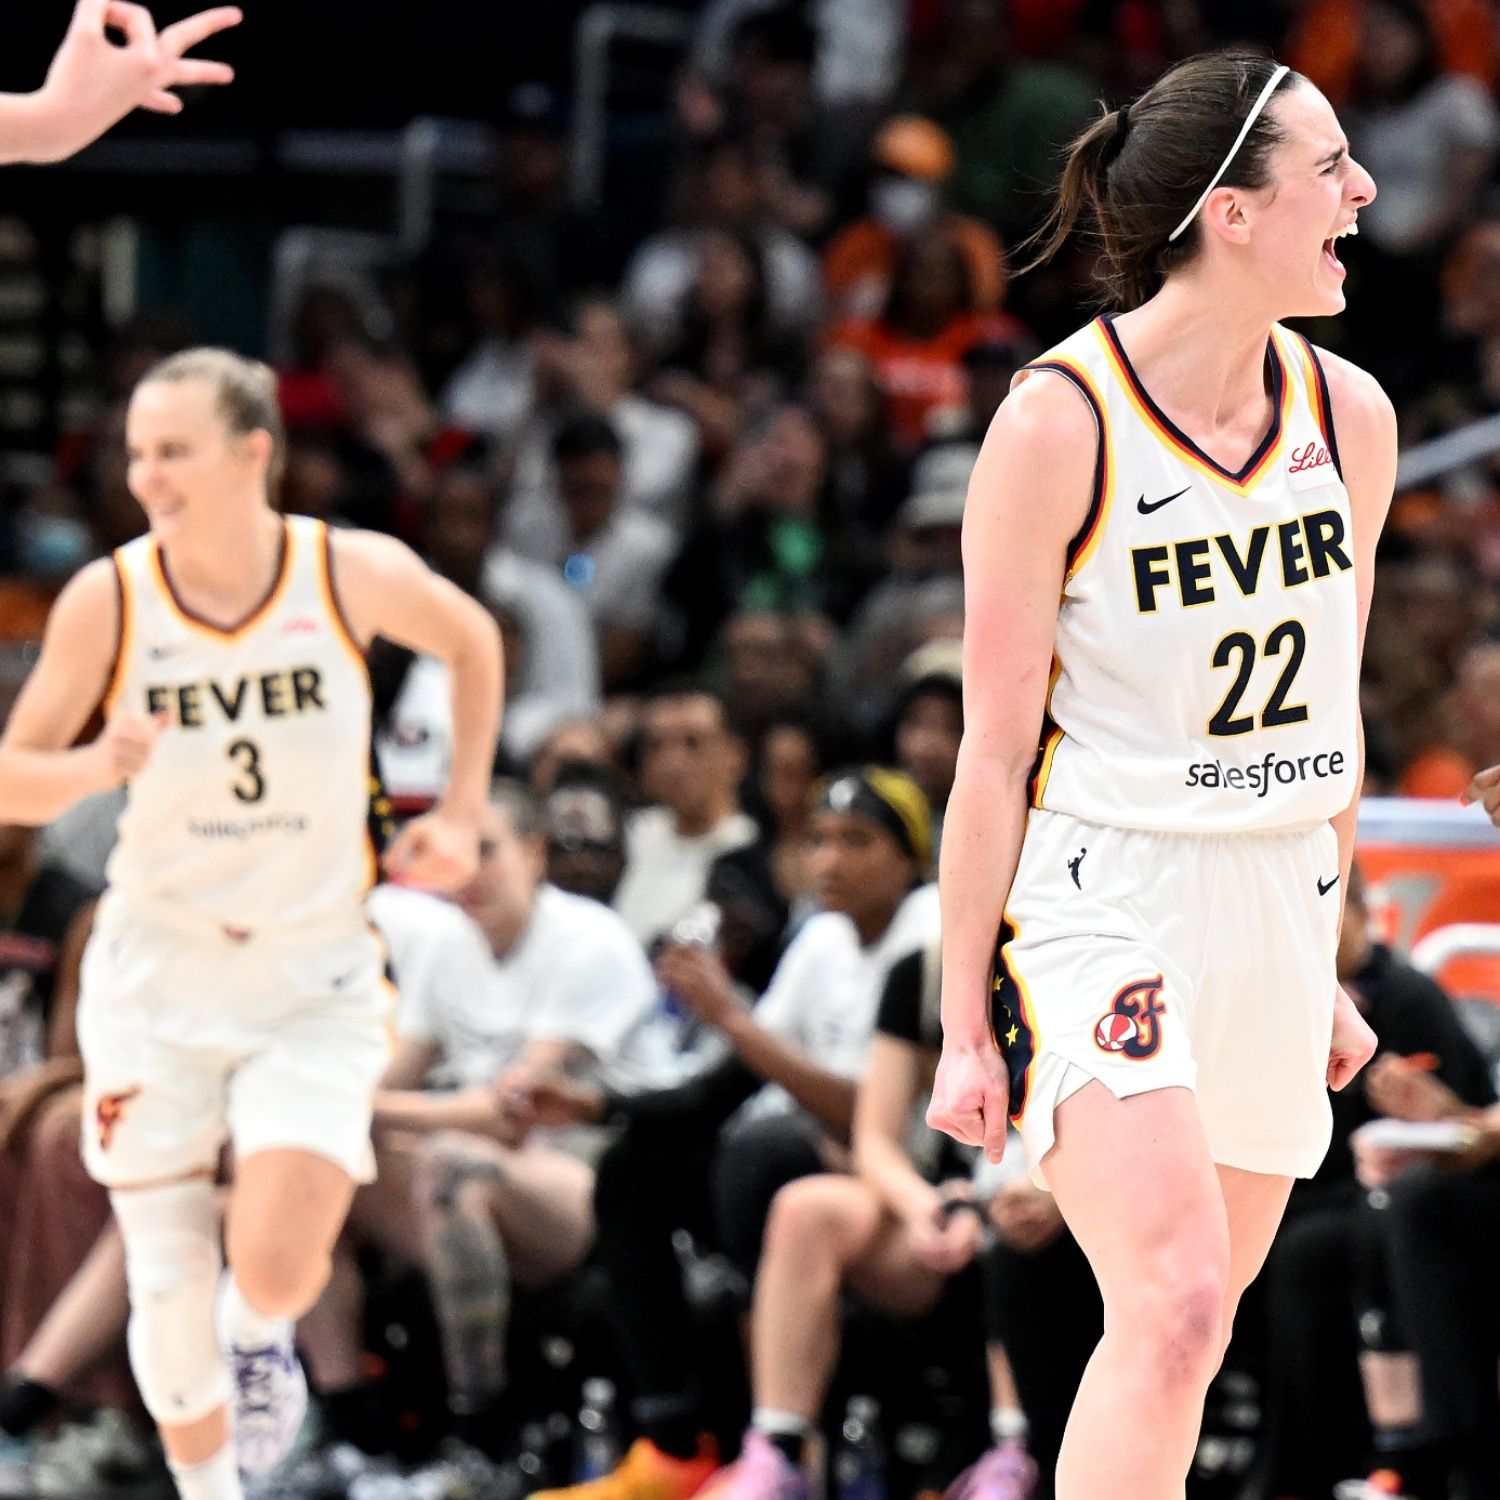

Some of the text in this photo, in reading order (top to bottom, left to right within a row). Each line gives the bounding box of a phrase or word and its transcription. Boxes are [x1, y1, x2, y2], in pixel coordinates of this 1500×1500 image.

[1130, 508, 1353, 614] FEVER
[145, 665, 325, 727] FEVER
[1206, 617, 1310, 738] 22
[227, 738, 266, 803] 3
[1186, 750, 1344, 798] salesforce
